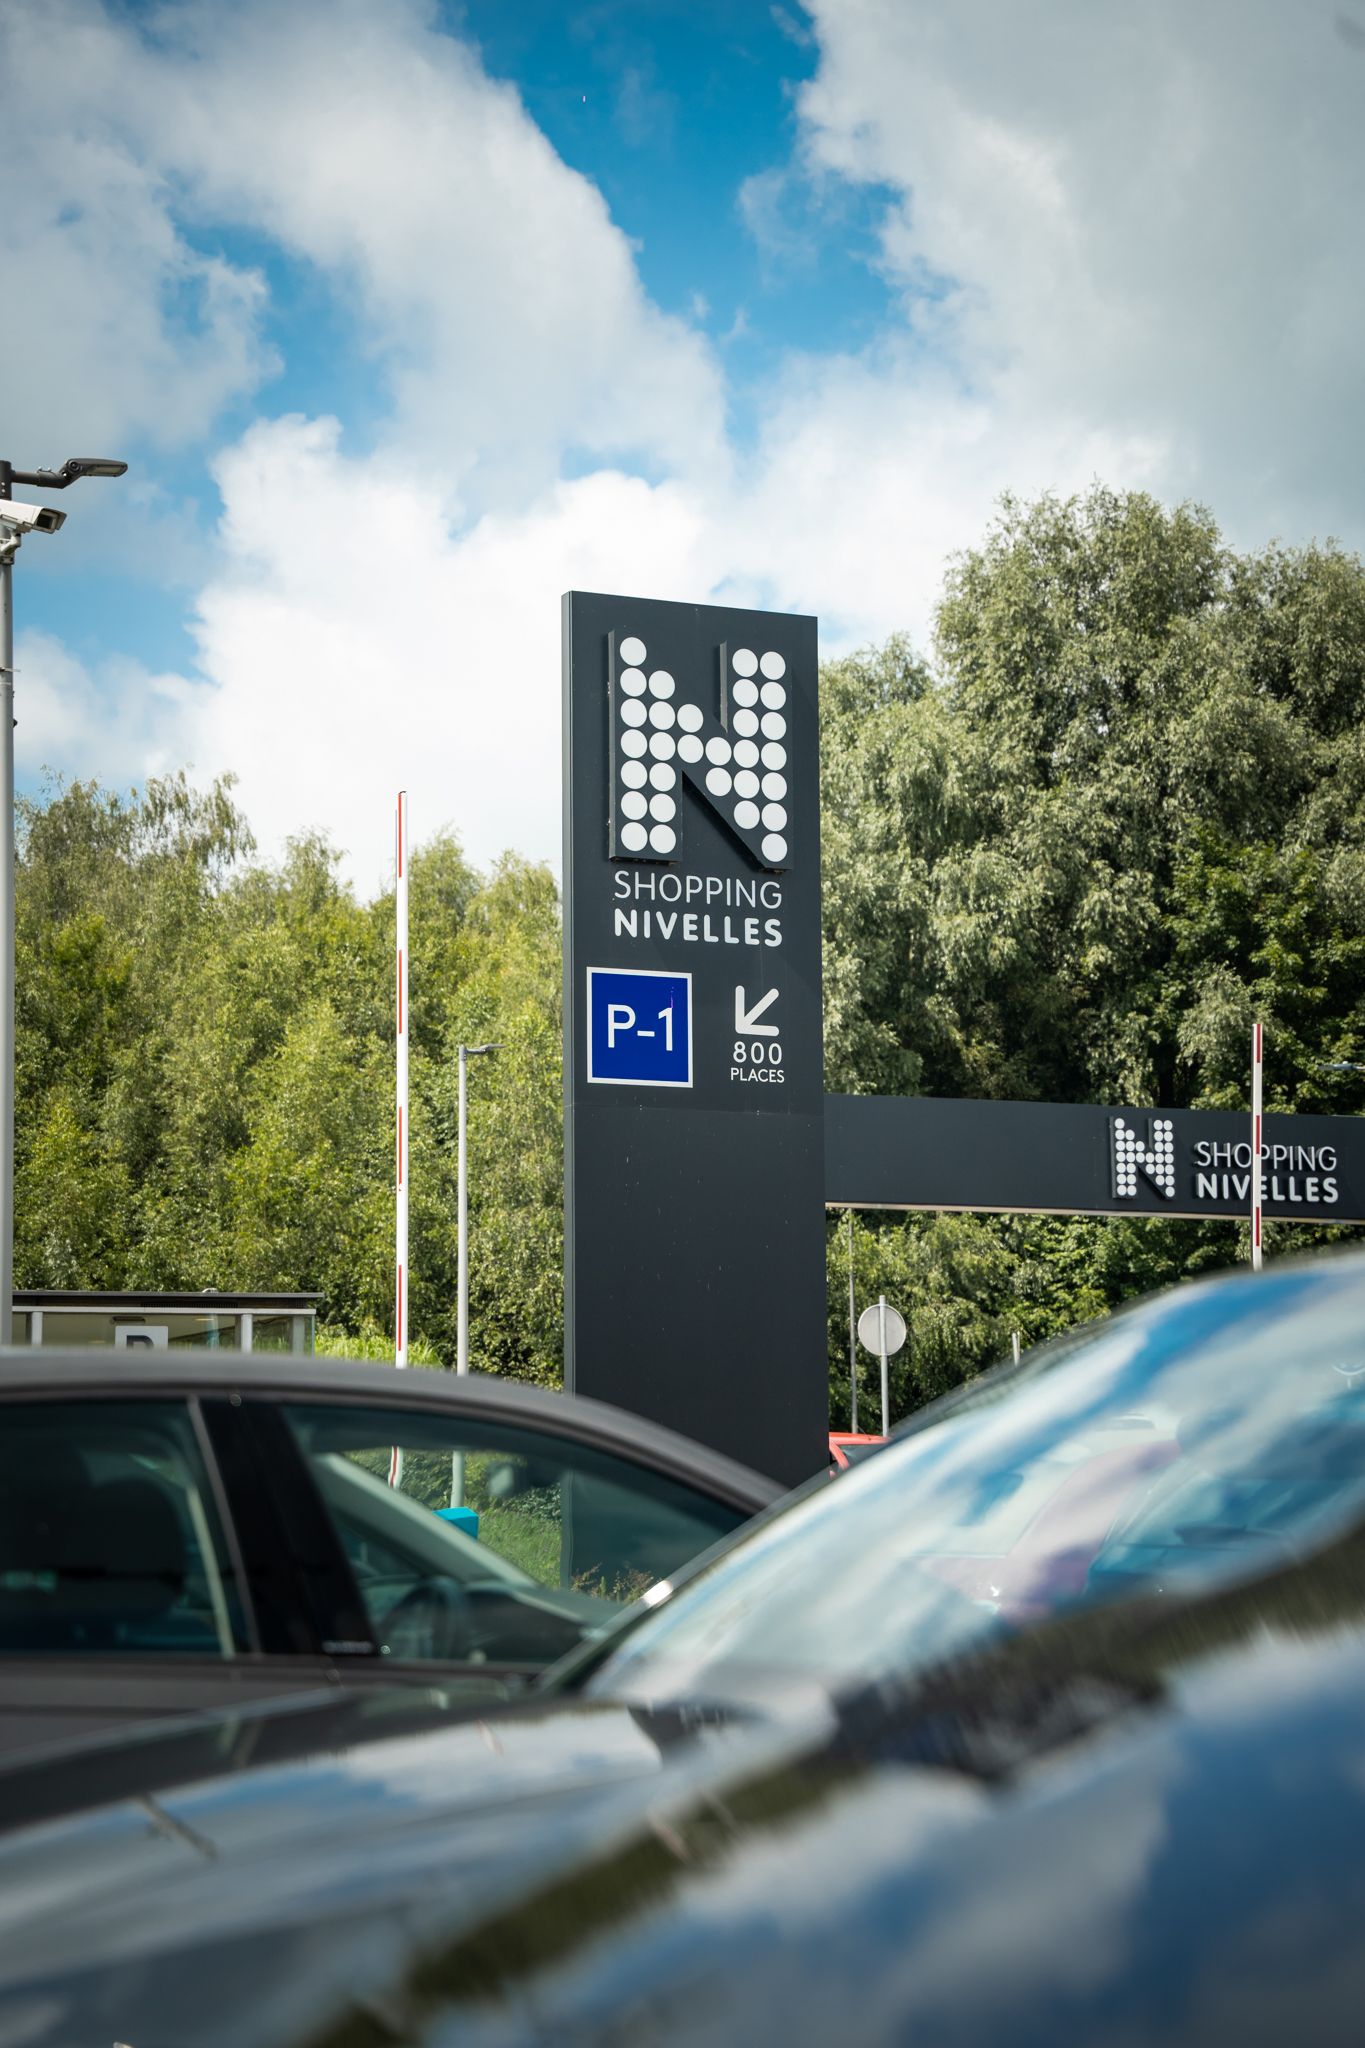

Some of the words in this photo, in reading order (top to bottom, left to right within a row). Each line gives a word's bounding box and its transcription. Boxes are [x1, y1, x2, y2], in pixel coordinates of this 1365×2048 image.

[613, 870, 783, 910] SHOPPING
[613, 908, 783, 947] NIVELLES
[607, 1003, 673, 1052] P-1
[733, 1041, 782, 1065] 800
[730, 1067, 785, 1083] PLACES
